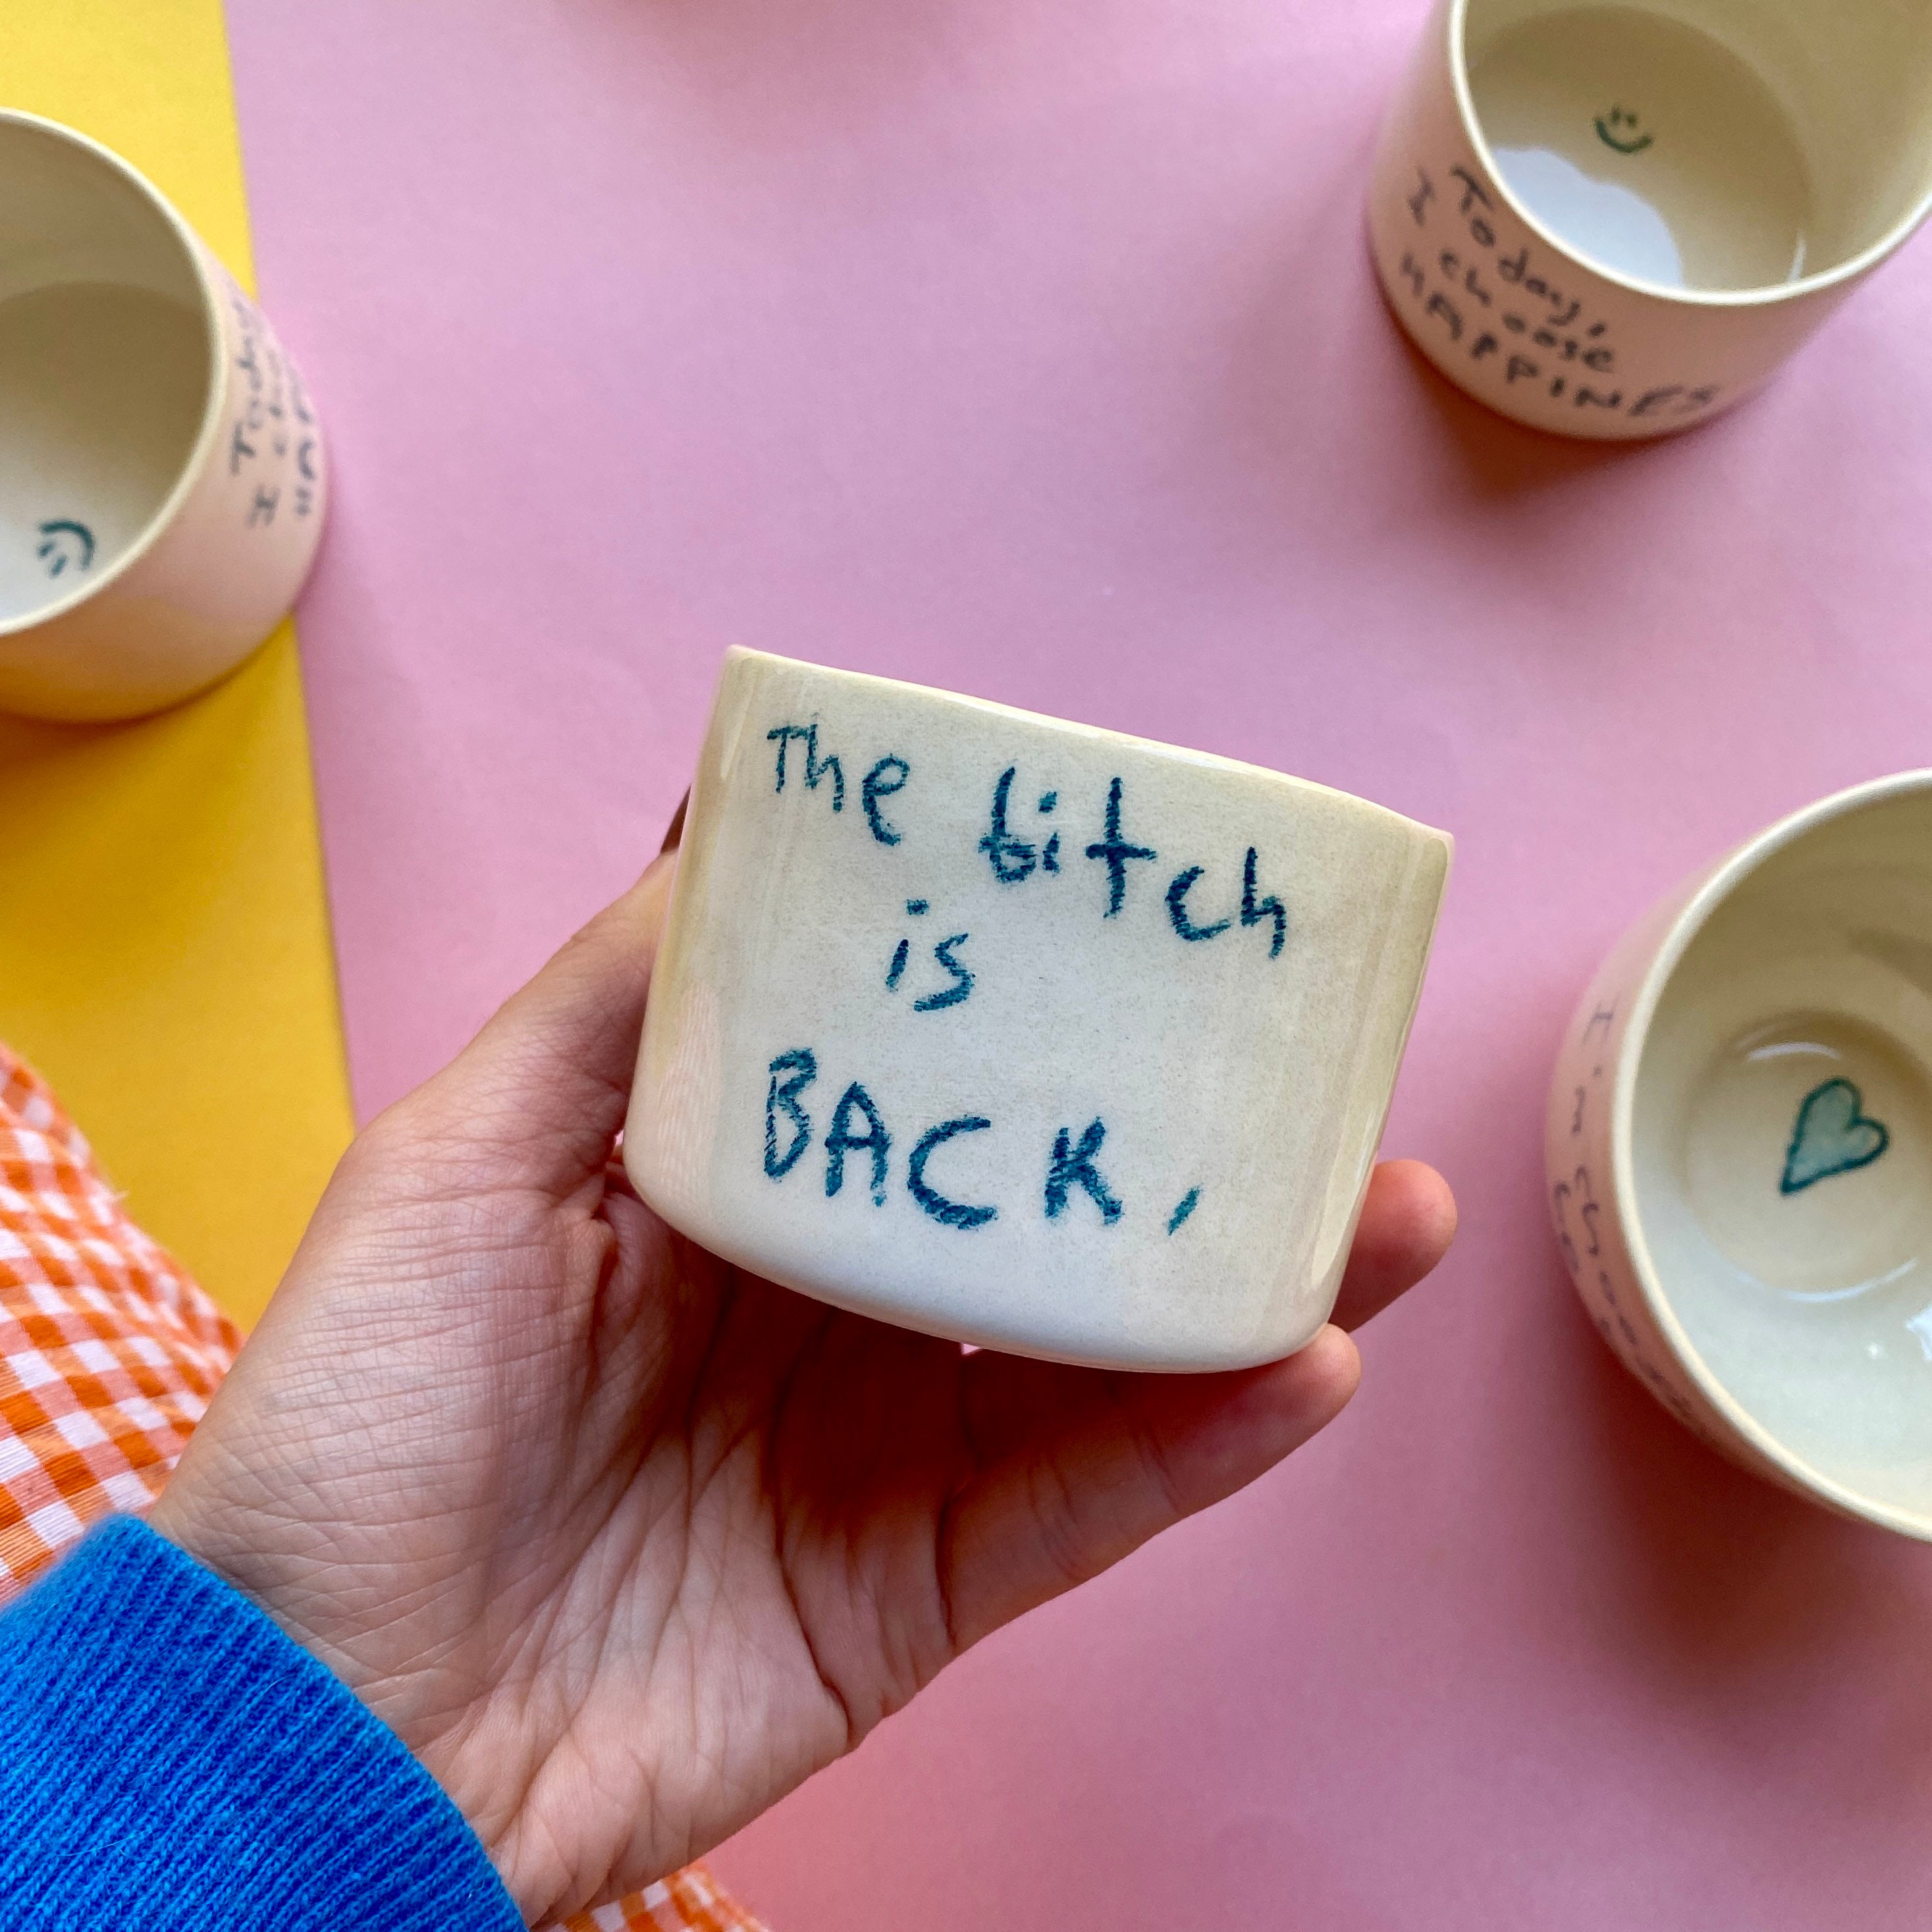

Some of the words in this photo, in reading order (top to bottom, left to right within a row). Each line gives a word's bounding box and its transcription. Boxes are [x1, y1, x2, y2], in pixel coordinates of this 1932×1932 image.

[1408, 166, 1436, 227] I
[766, 718, 911, 846] The
[886, 898, 976, 1013] is
